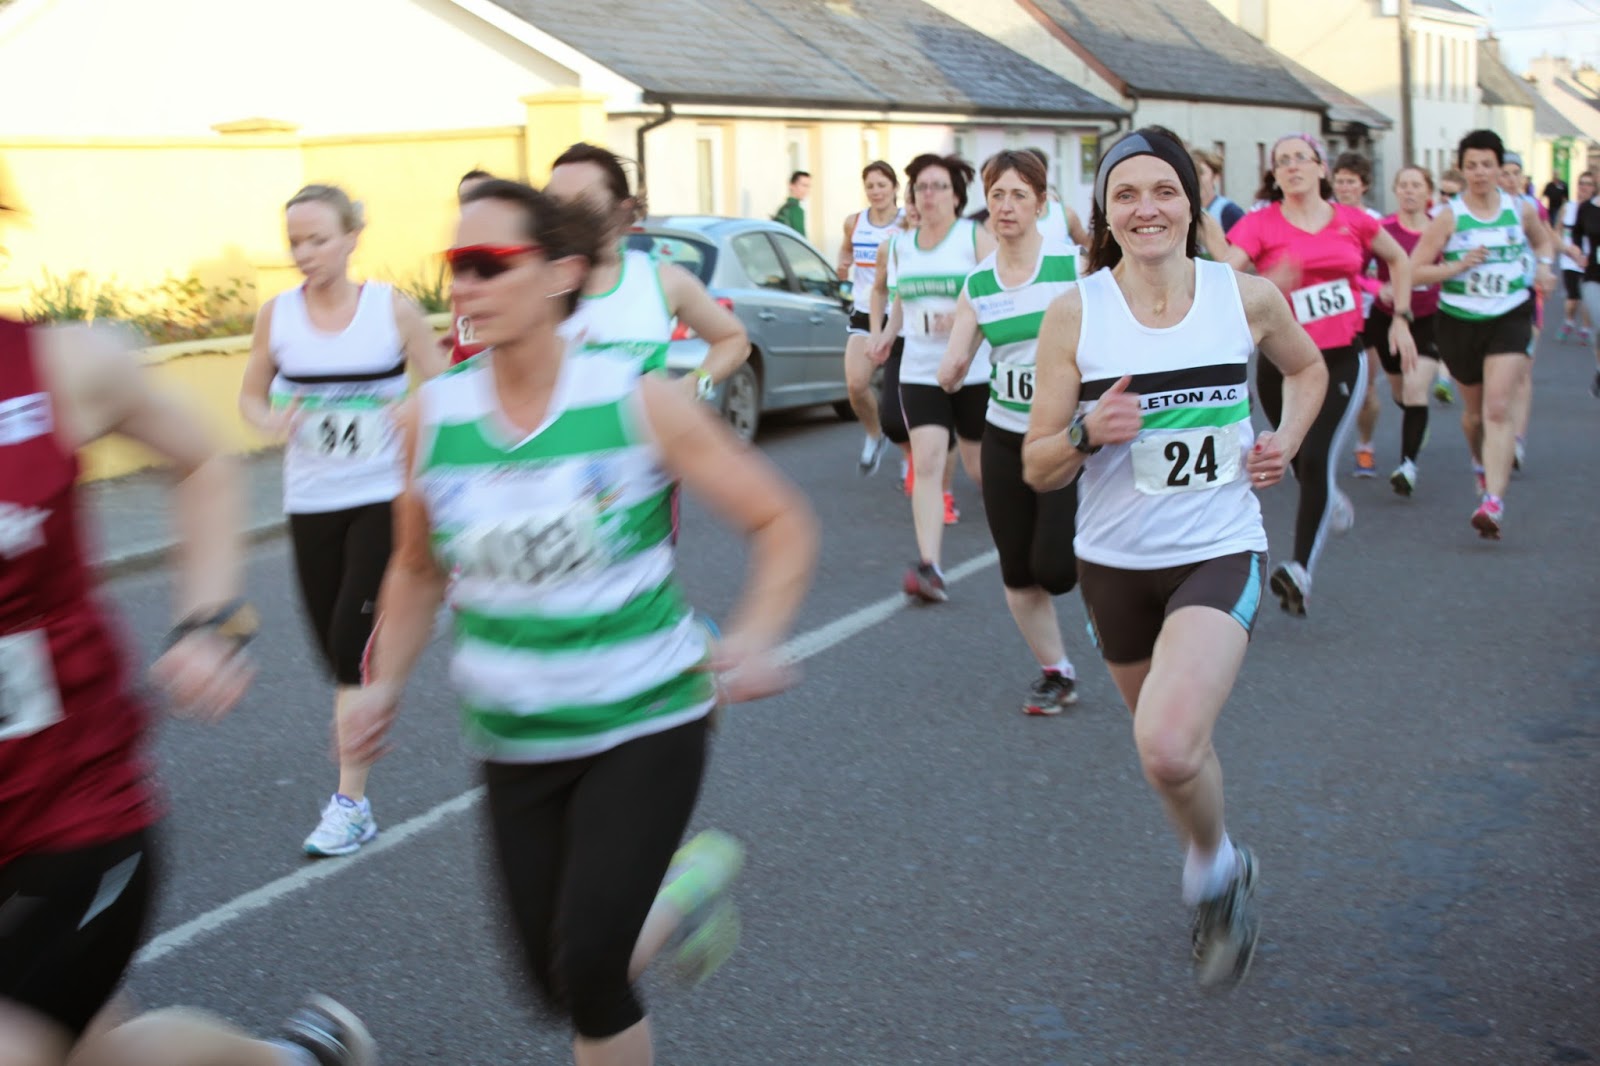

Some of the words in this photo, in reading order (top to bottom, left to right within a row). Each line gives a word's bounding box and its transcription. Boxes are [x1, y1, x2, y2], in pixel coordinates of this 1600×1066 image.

[1305, 284, 1346, 317] 155
[1006, 369, 1034, 402] 16
[1209, 388, 1238, 402] A.C.
[1164, 434, 1219, 488] 24
